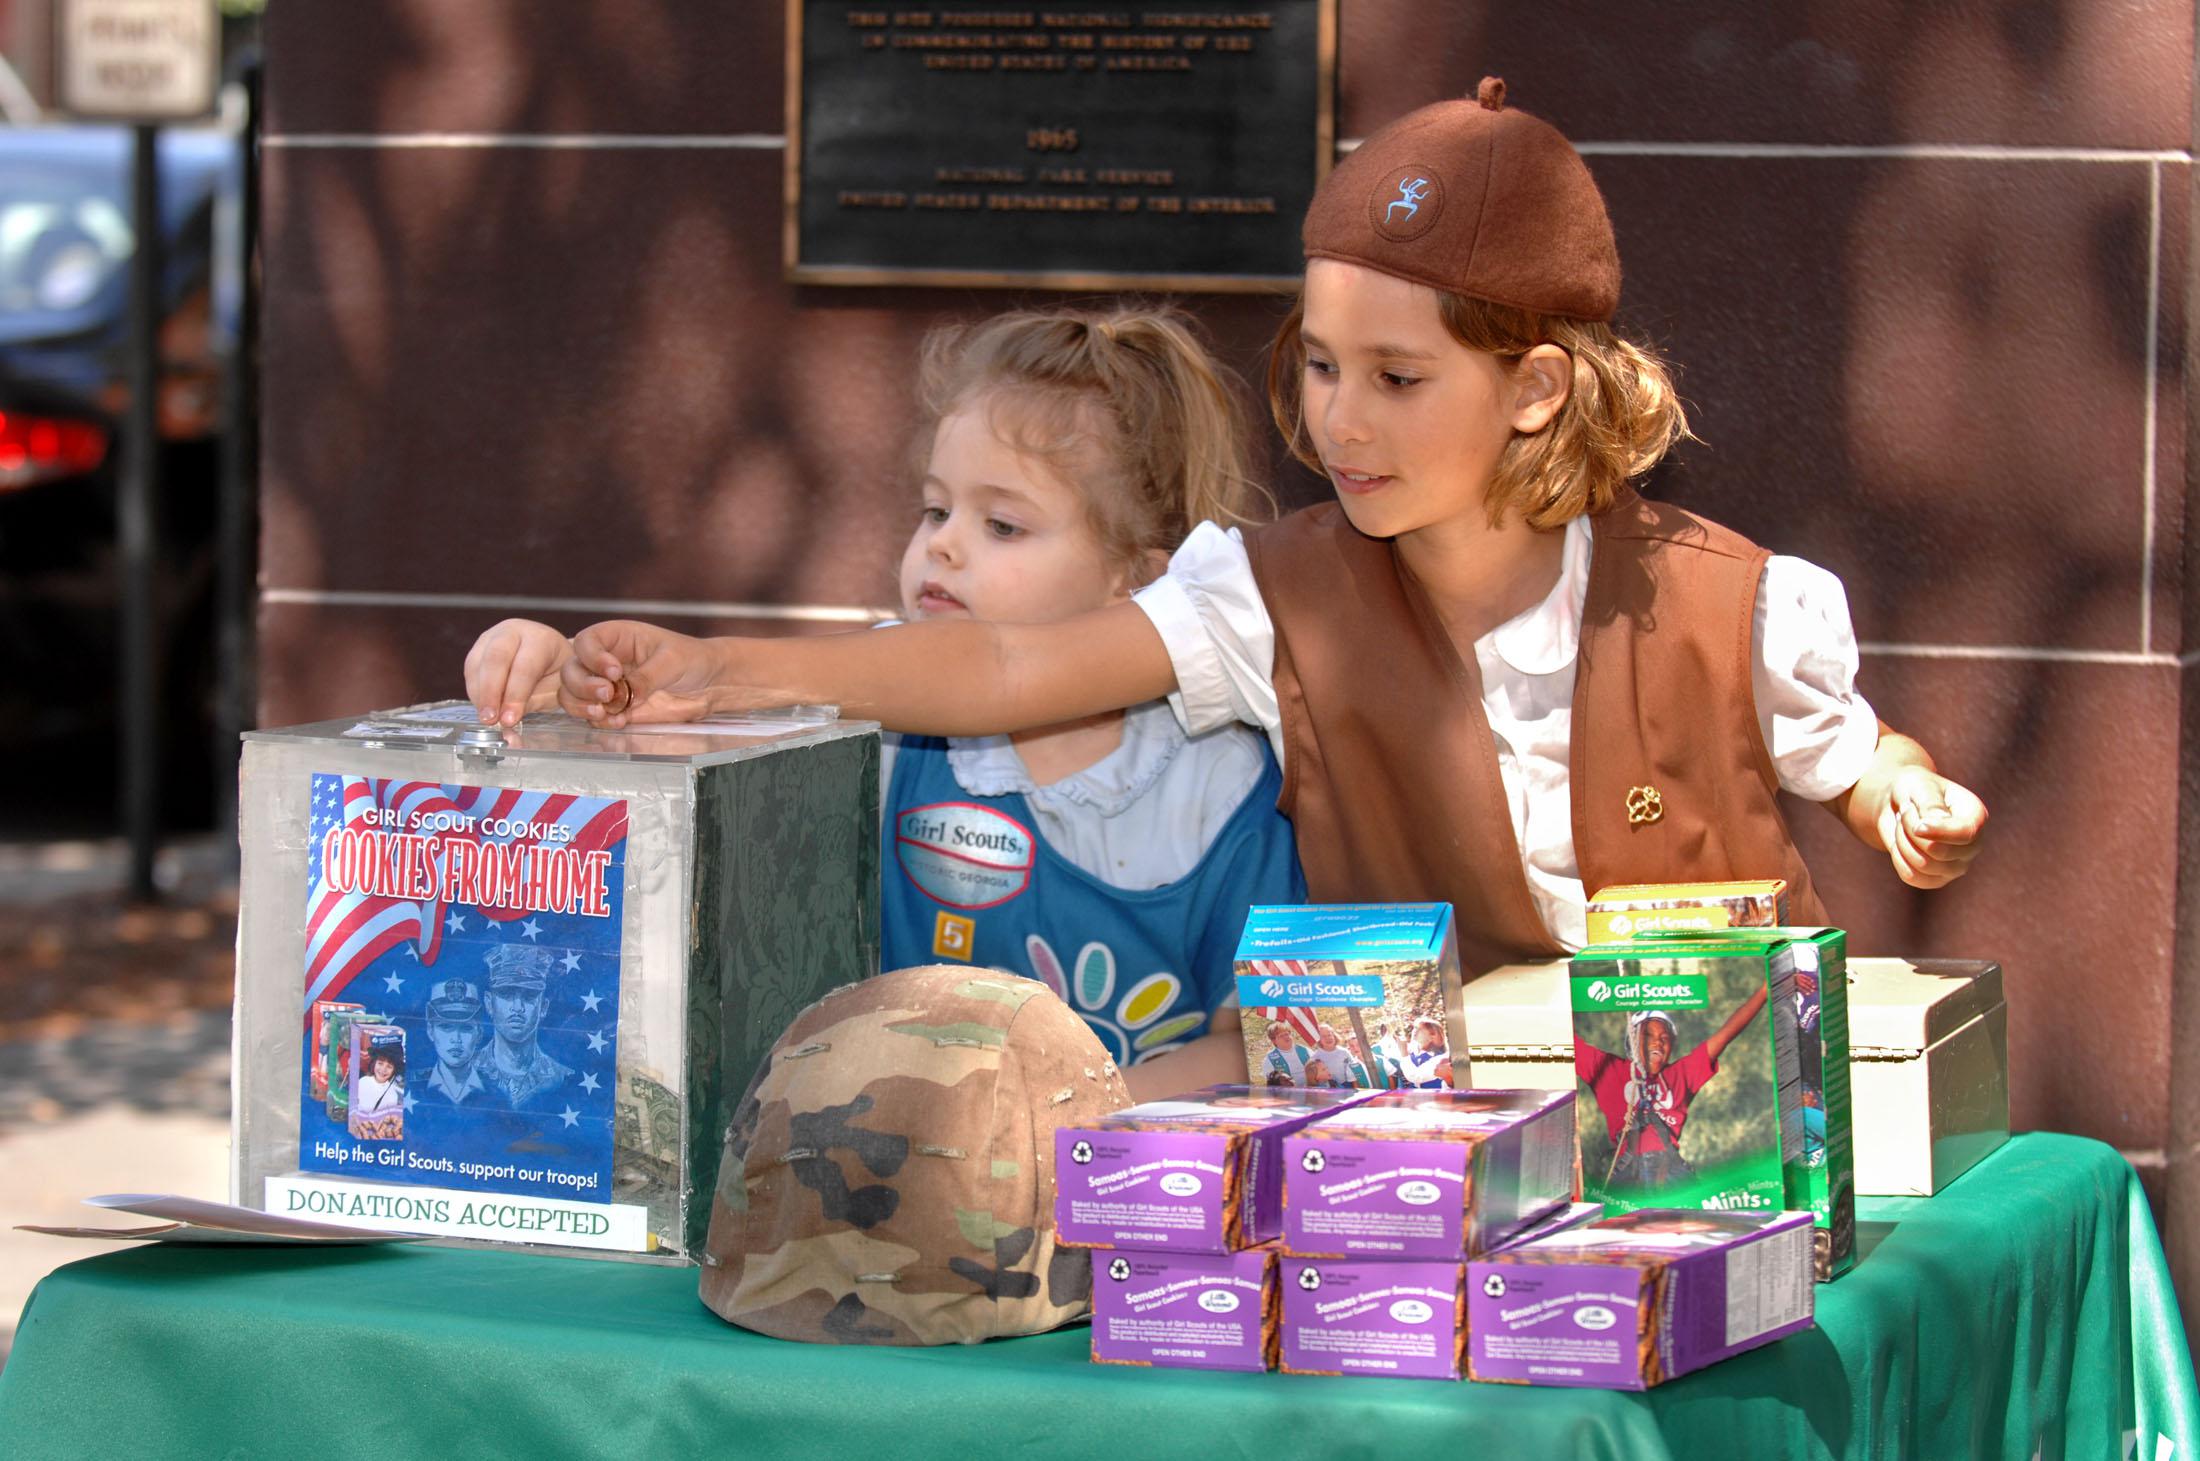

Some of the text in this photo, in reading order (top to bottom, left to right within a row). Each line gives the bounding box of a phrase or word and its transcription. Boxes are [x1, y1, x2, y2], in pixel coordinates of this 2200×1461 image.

[362, 808, 406, 829] GIRL
[410, 811, 477, 834] SCOUT
[907, 816, 946, 842] Girl
[321, 826, 613, 918] COOKIES FROM HOME
[942, 921, 964, 950] 5
[1635, 917, 1660, 931] Girl
[1287, 982, 1313, 997] Girl
[1614, 983, 1640, 998] Girl
[315, 1141, 348, 1164] Help
[352, 1146, 375, 1164] the
[378, 1148, 405, 1167] Girl
[459, 1159, 516, 1182] support
[518, 1169, 543, 1182] our
[547, 1170, 599, 1192] troops!
[287, 1188, 611, 1237] DONATIONS ACCEPTED
[1702, 1191, 1751, 1210] Mints
